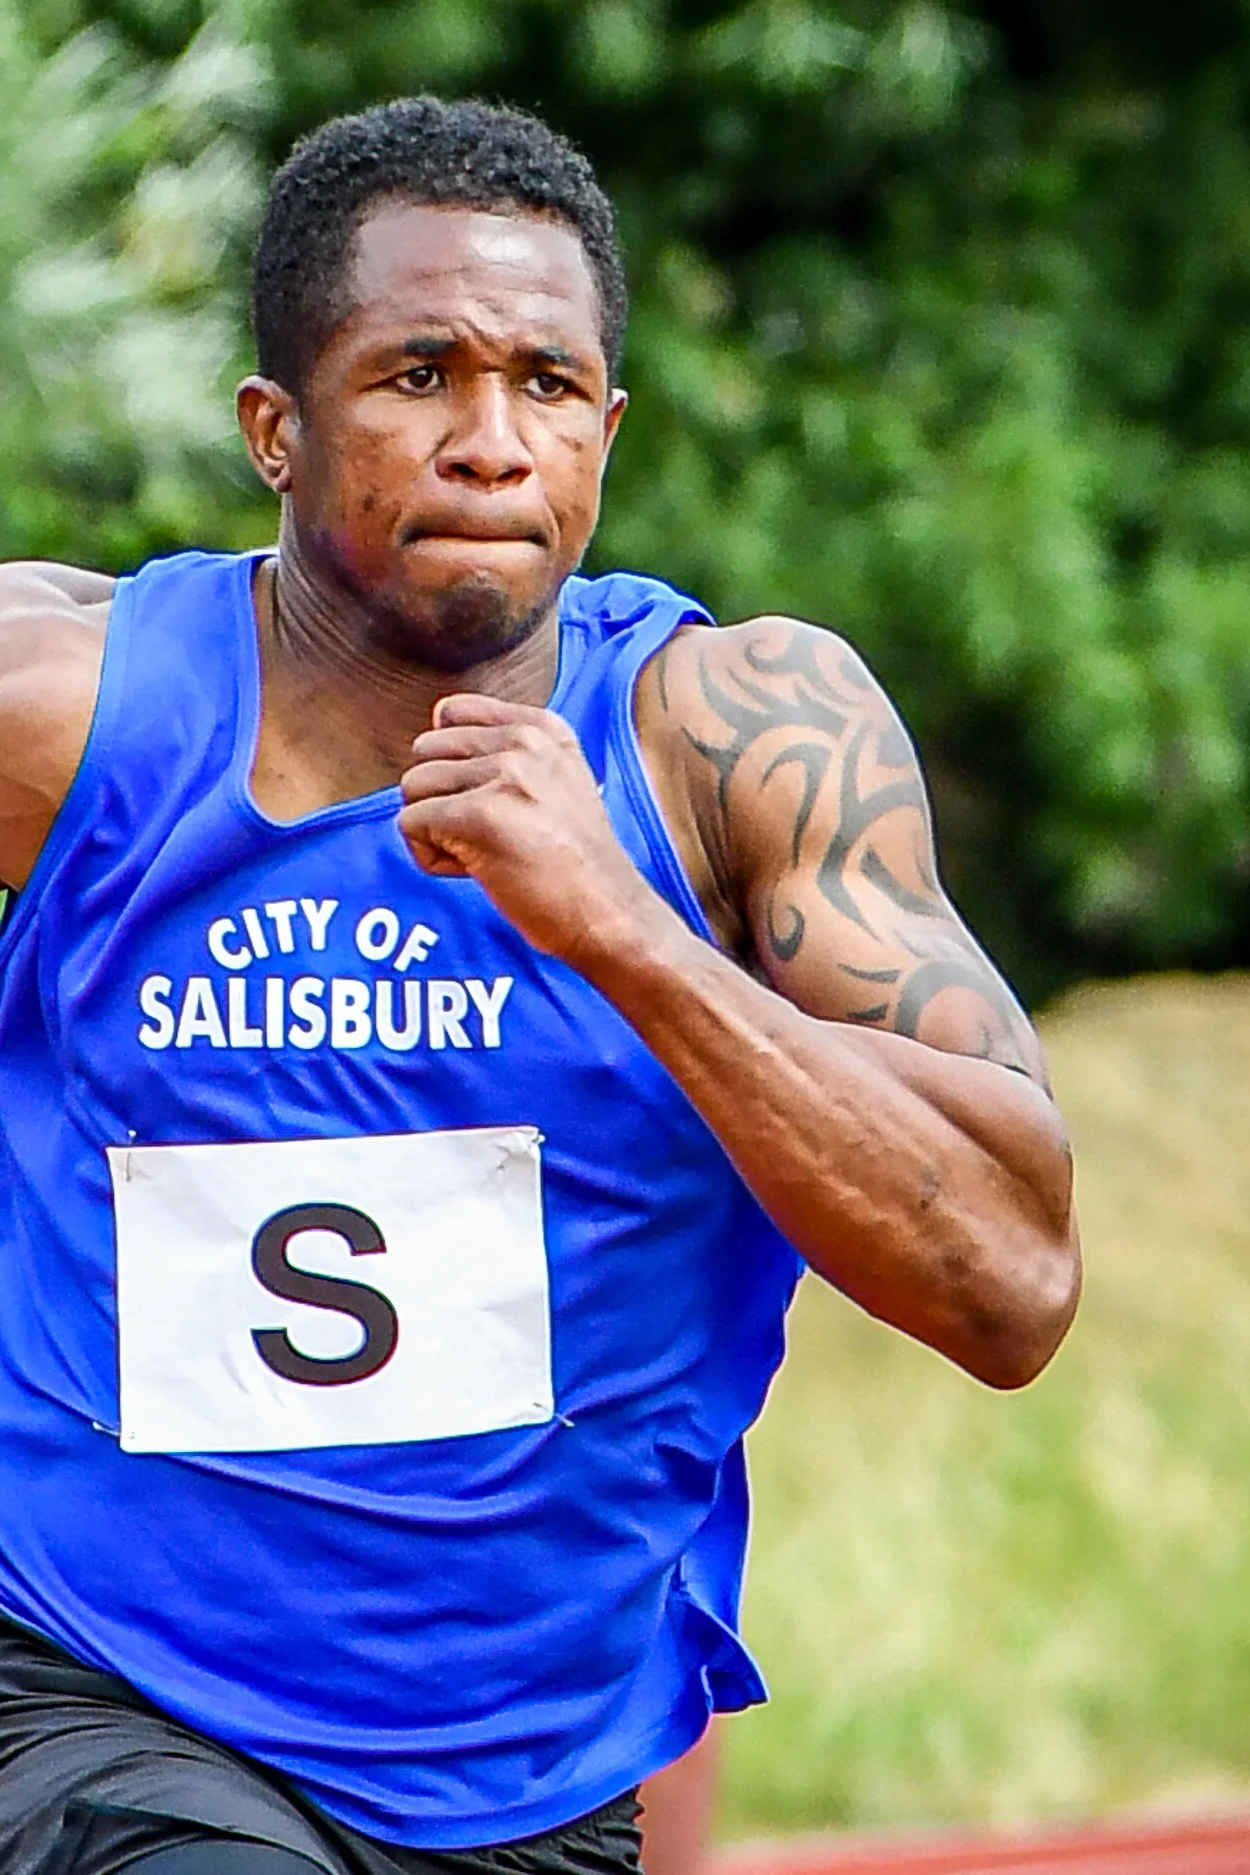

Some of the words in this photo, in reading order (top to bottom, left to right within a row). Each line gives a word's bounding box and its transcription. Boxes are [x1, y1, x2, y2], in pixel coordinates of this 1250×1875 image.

[207, 898, 338, 969] CITY
[355, 907, 439, 972] OF
[138, 975, 513, 1050] SALISBURY
[250, 1202, 399, 1386] S
